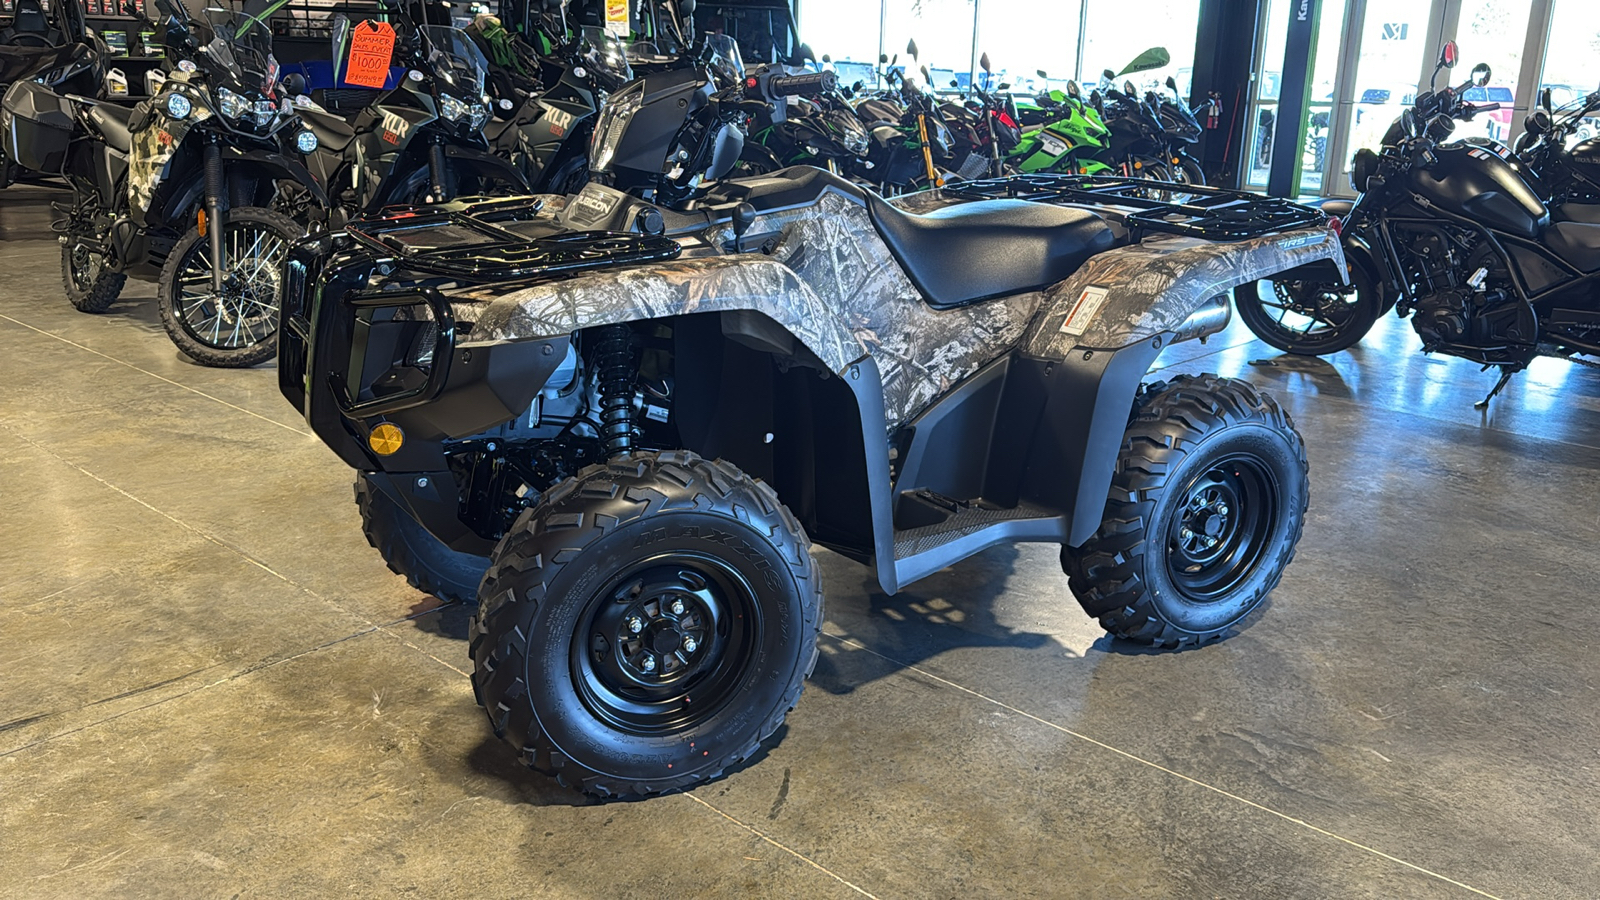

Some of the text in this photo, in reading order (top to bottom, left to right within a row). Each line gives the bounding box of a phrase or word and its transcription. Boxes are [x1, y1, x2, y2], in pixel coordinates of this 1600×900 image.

[355, 34, 392, 47] SUMMER
[381, 112, 409, 139] KLR
[543, 105, 571, 130] KLR
[632, 525, 784, 593] MAXXIS
